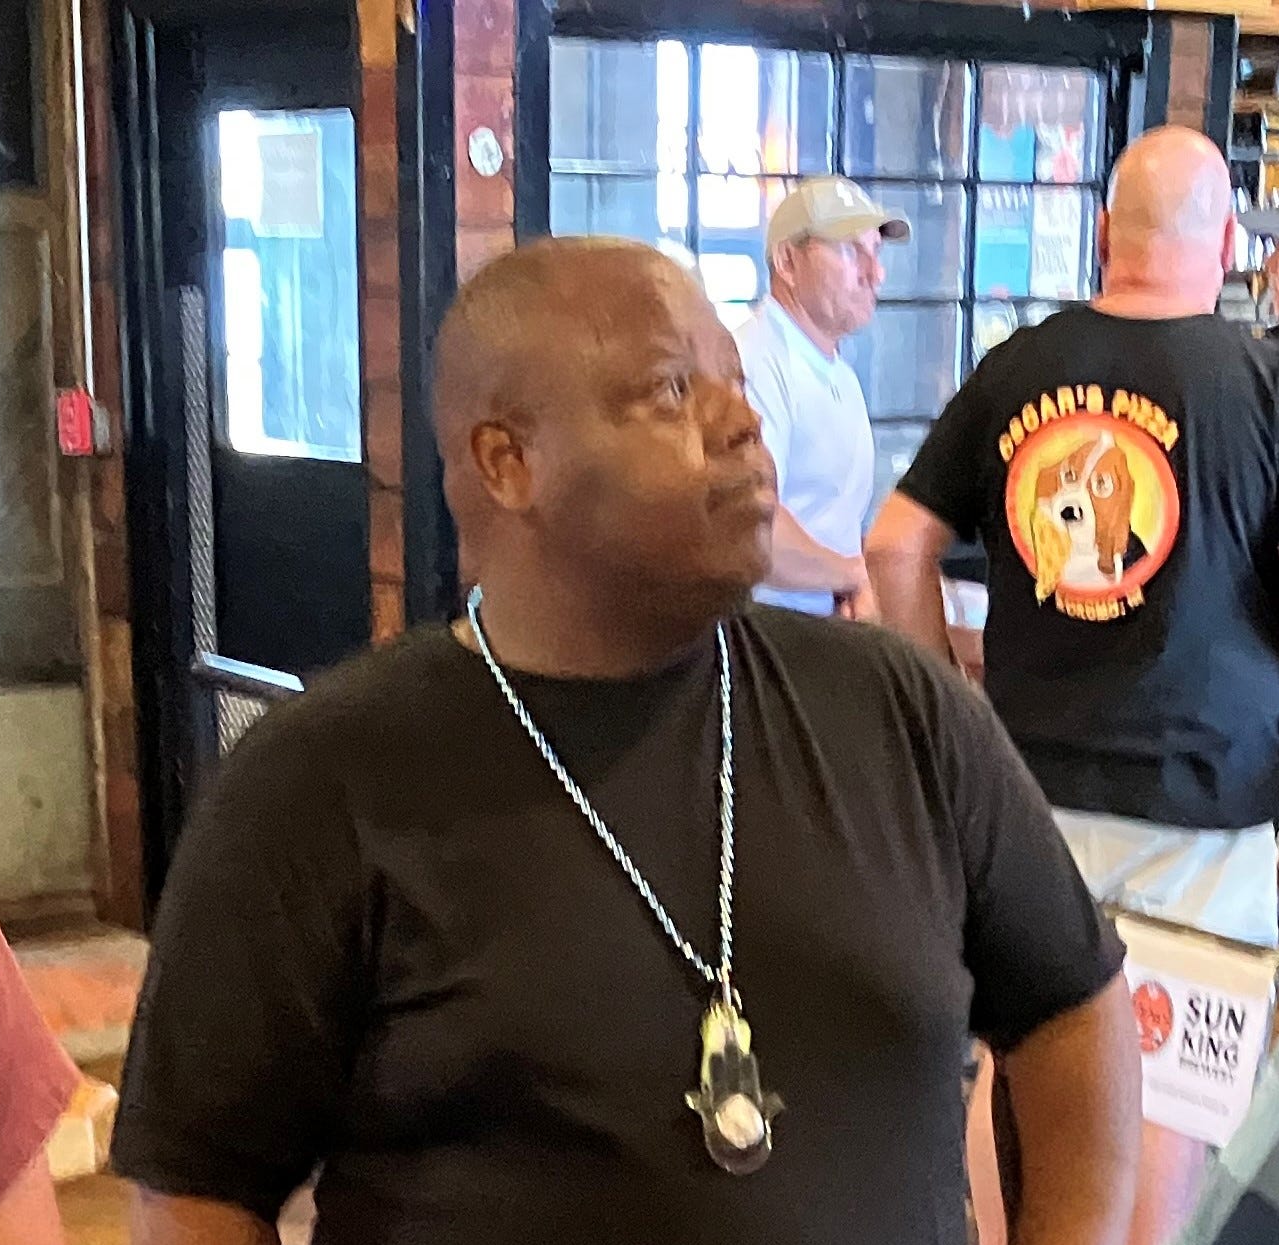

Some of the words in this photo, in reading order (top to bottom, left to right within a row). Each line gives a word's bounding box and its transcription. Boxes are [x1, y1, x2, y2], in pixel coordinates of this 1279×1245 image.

[1111, 388, 1180, 453] PIZZA
[1184, 994, 1246, 1038] SUN
[1181, 1026, 1239, 1068] KING
